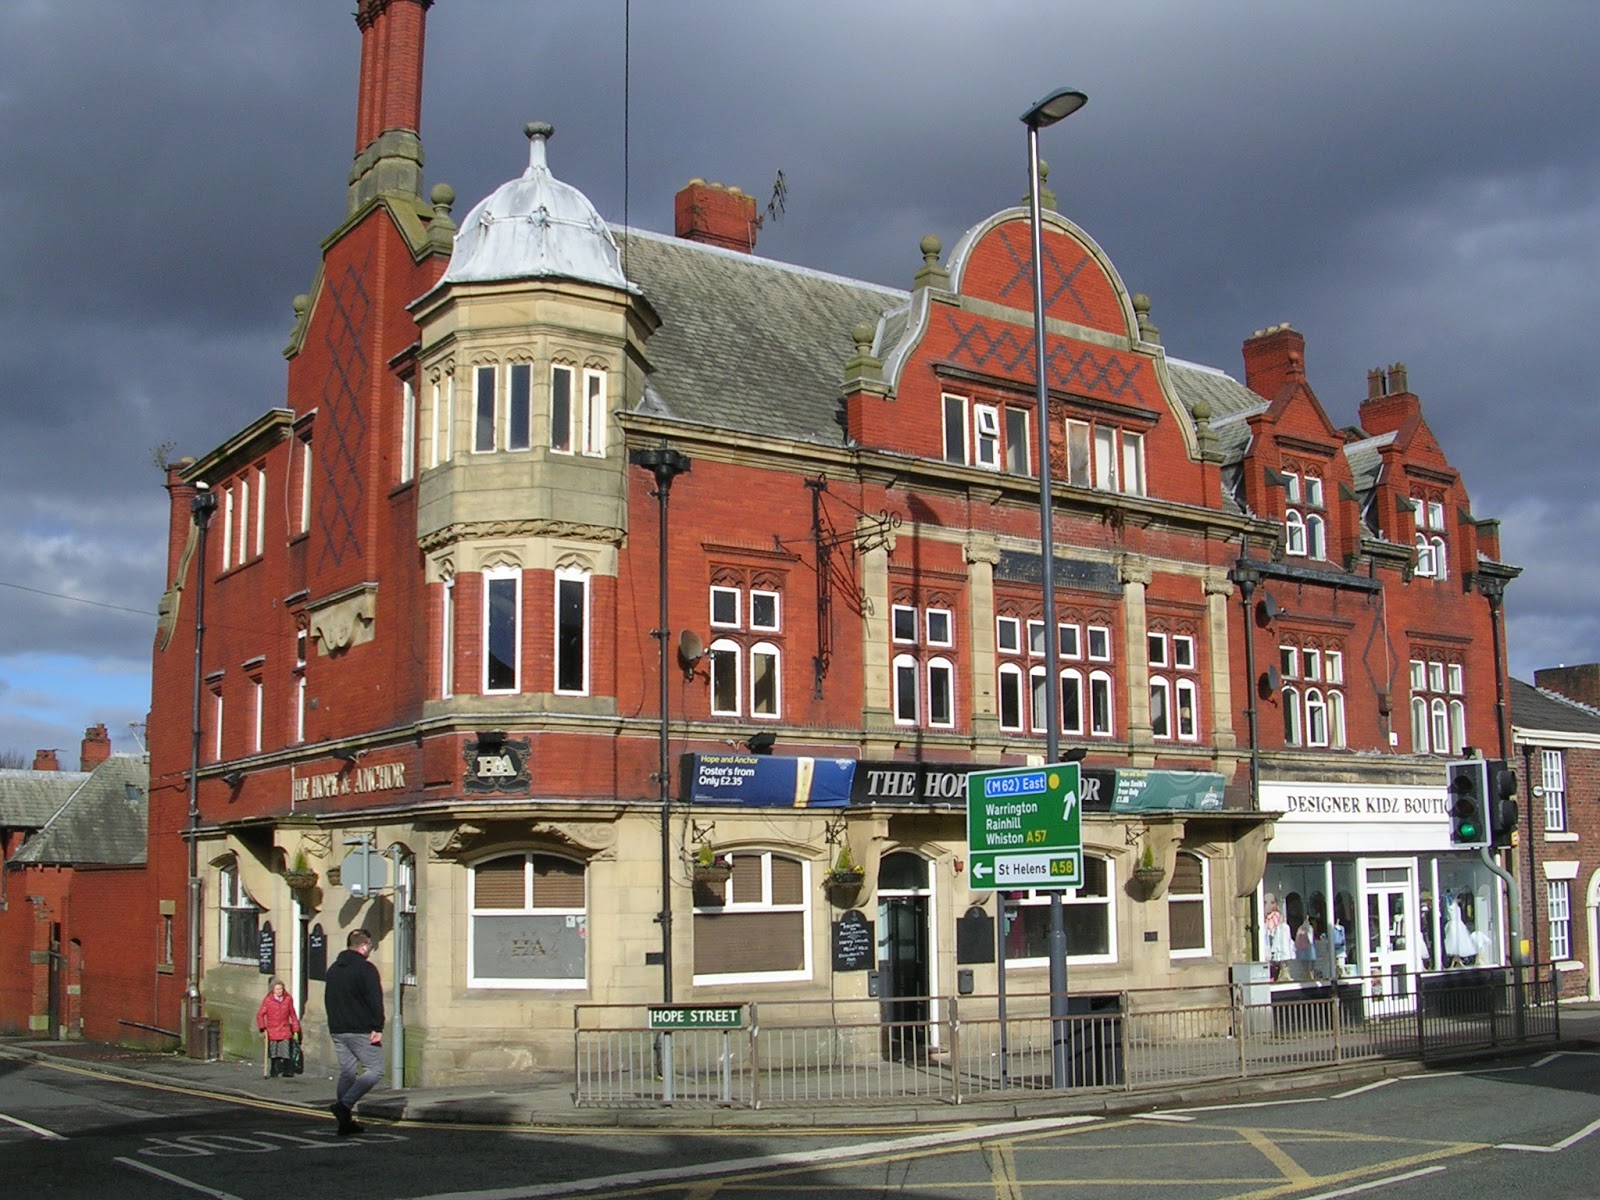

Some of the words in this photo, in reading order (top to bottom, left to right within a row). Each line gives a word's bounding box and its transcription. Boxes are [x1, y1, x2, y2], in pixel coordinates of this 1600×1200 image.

[701, 756, 720, 764] Hope
[735, 757, 759, 765] Anchor
[354, 762, 406, 794] ANCHOR
[700, 766, 733, 776] Foster's
[734, 767, 755, 776] from
[699, 776, 719, 788] Only
[720, 777, 743, 786] £2.35
[867, 771, 916, 797] THE
[924, 772, 968, 798] HOP
[986, 777, 1019, 794] (M62)
[1023, 776, 1045, 790] East
[985, 802, 1038, 817] Warrington
[1287, 795, 1361, 814] DESIGNER
[1365, 797, 1400, 814] KIDZ
[986, 817, 1021, 830] Rainhill
[986, 832, 1024, 845] Whiston
[1026, 830, 1047, 843] A57
[998, 864, 1010, 876] St
[1013, 864, 1047, 875] Helens
[1051, 860, 1073, 874] A58
[653, 1010, 684, 1022] HOPE
[690, 1010, 737, 1022] STREET
